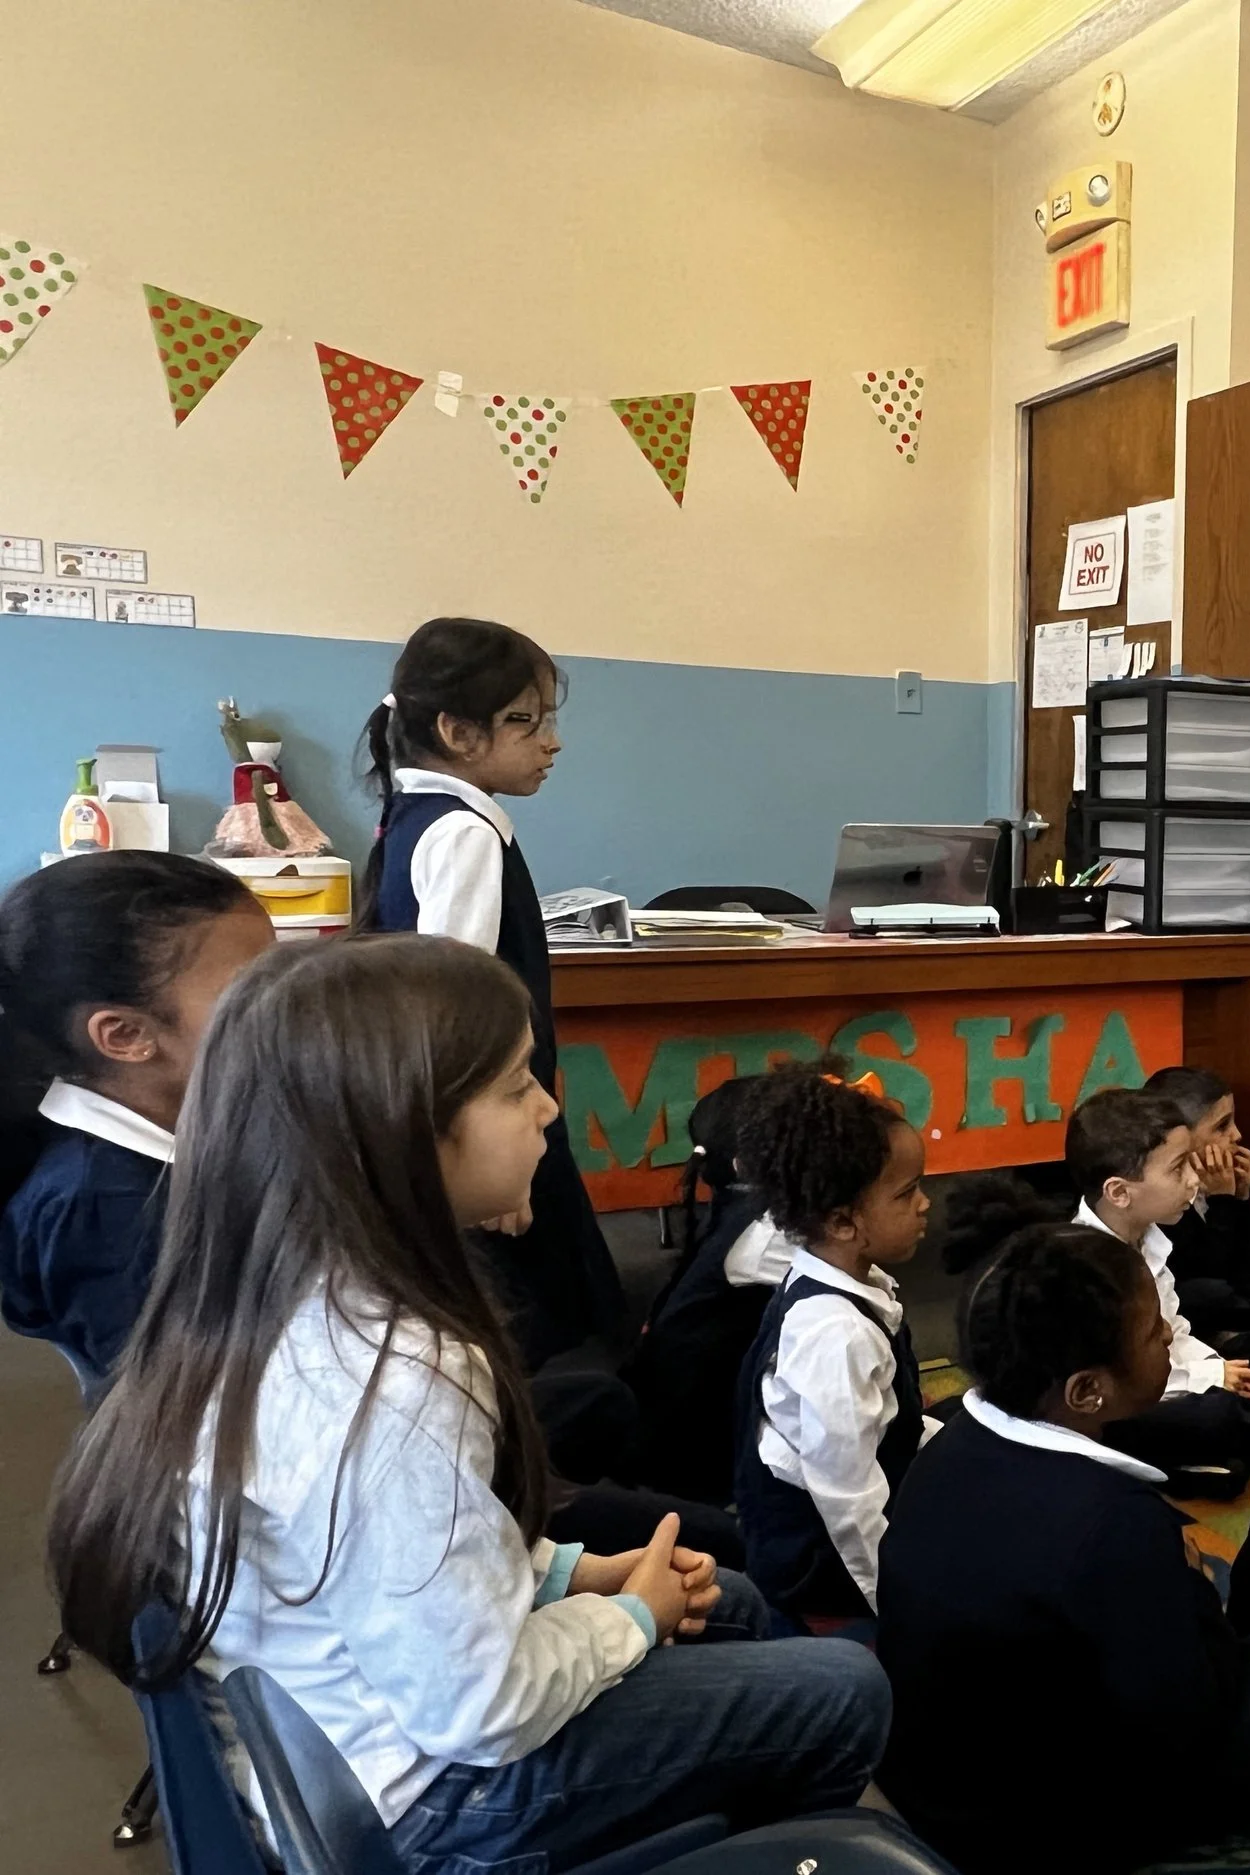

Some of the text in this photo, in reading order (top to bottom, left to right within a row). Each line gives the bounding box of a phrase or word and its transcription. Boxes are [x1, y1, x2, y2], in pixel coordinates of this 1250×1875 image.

[1057, 243, 1104, 327] EXIT
[1084, 543, 1104, 564] NO
[1076, 565, 1110, 587] EXIT
